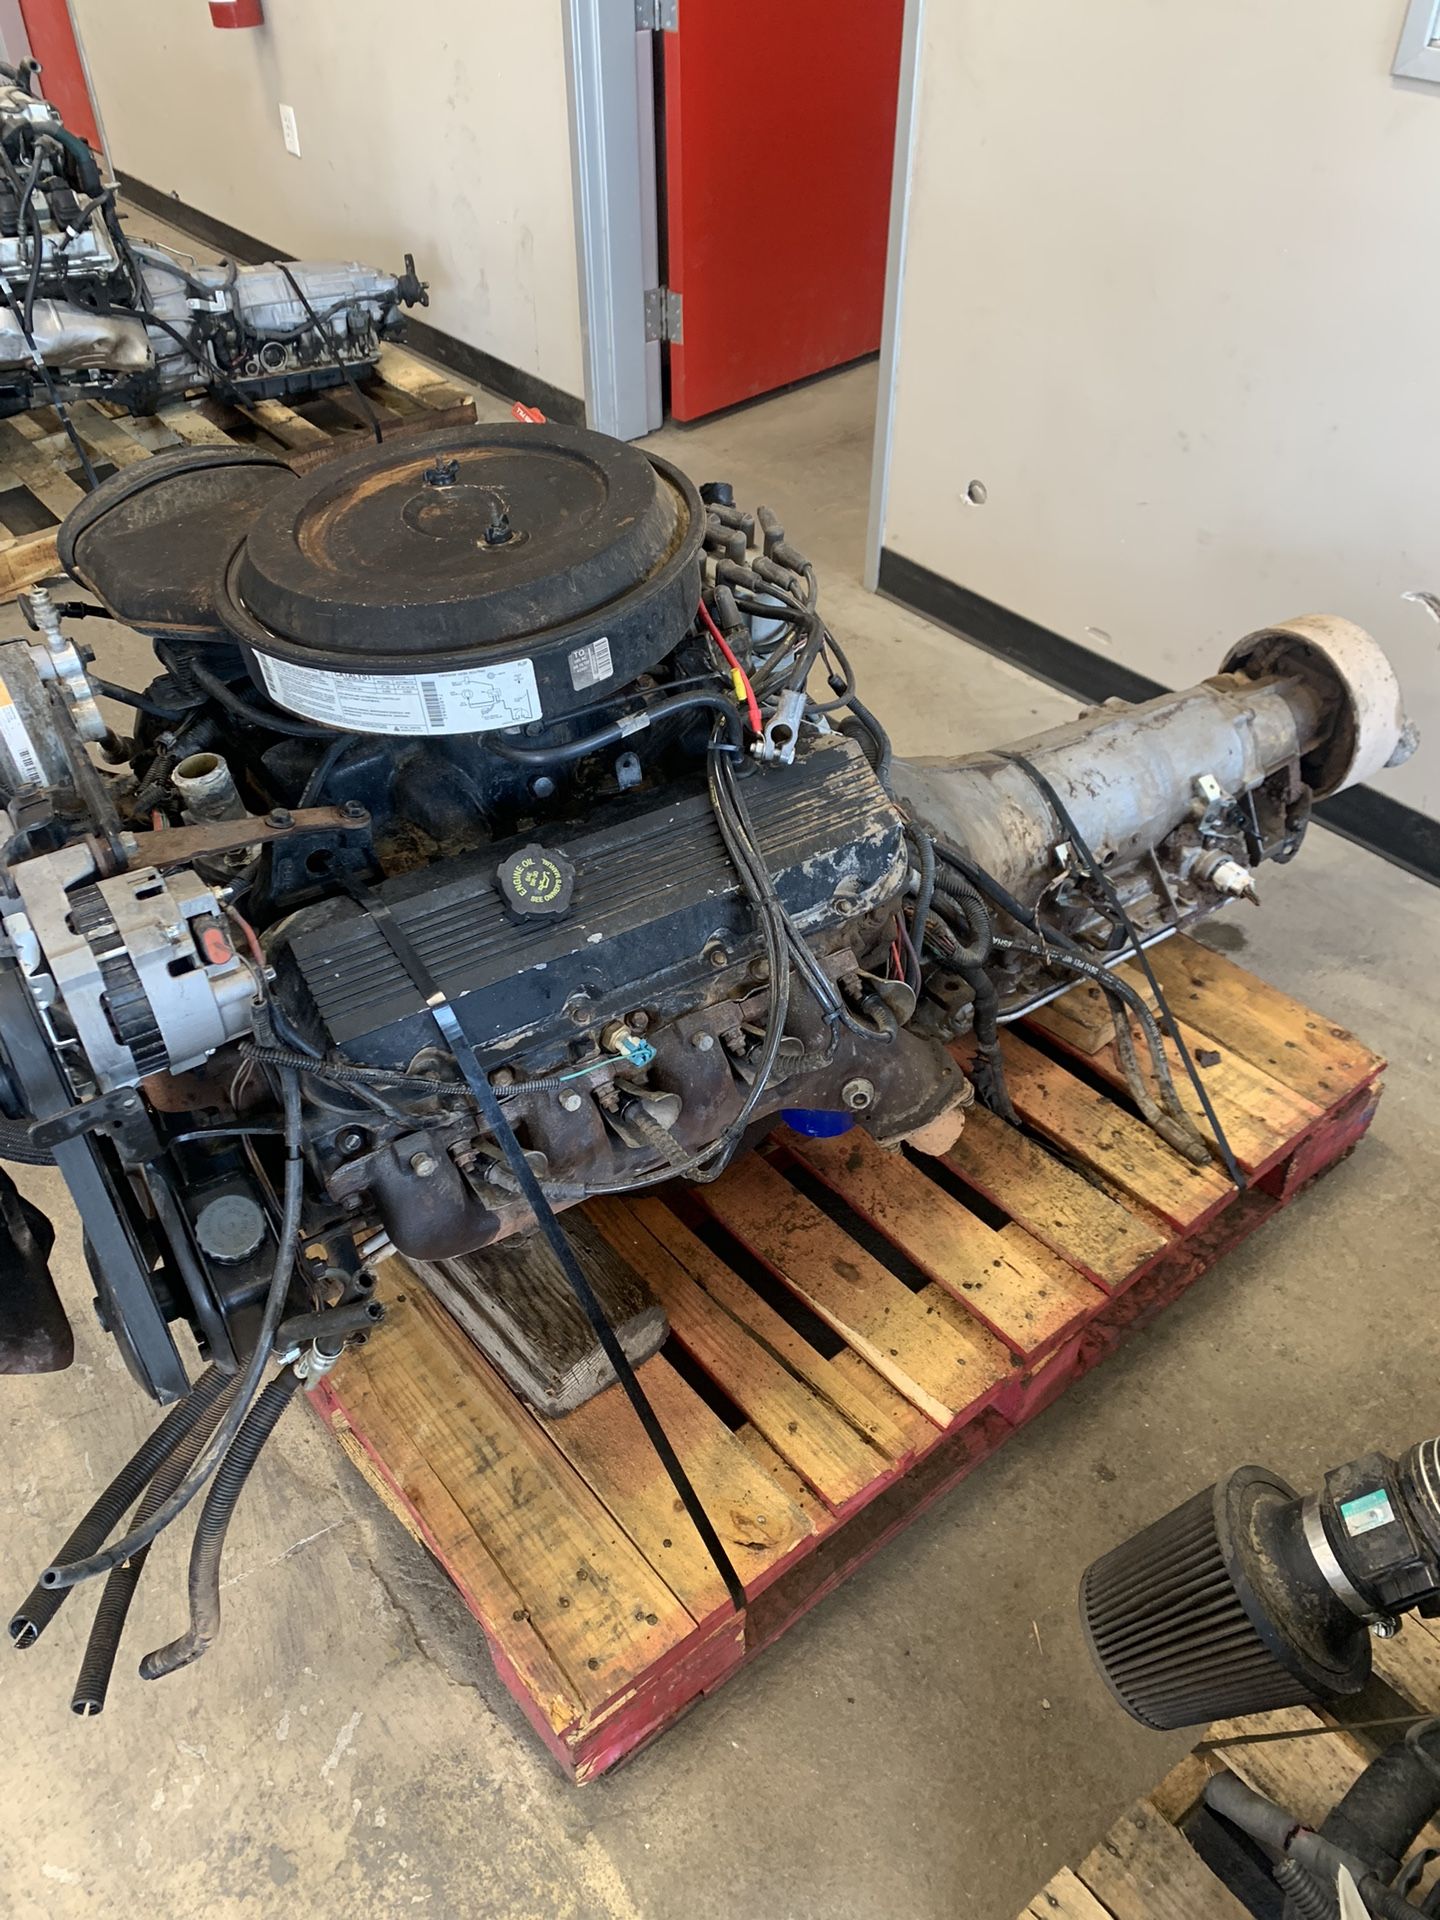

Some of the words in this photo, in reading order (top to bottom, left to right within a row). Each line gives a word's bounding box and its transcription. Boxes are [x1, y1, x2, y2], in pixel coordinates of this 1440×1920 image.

[574, 649, 584, 658] TO
[513, 865, 527, 896] ENGINE
[521, 858, 535, 868] OIL
[541, 858, 561, 878] MANUAL
